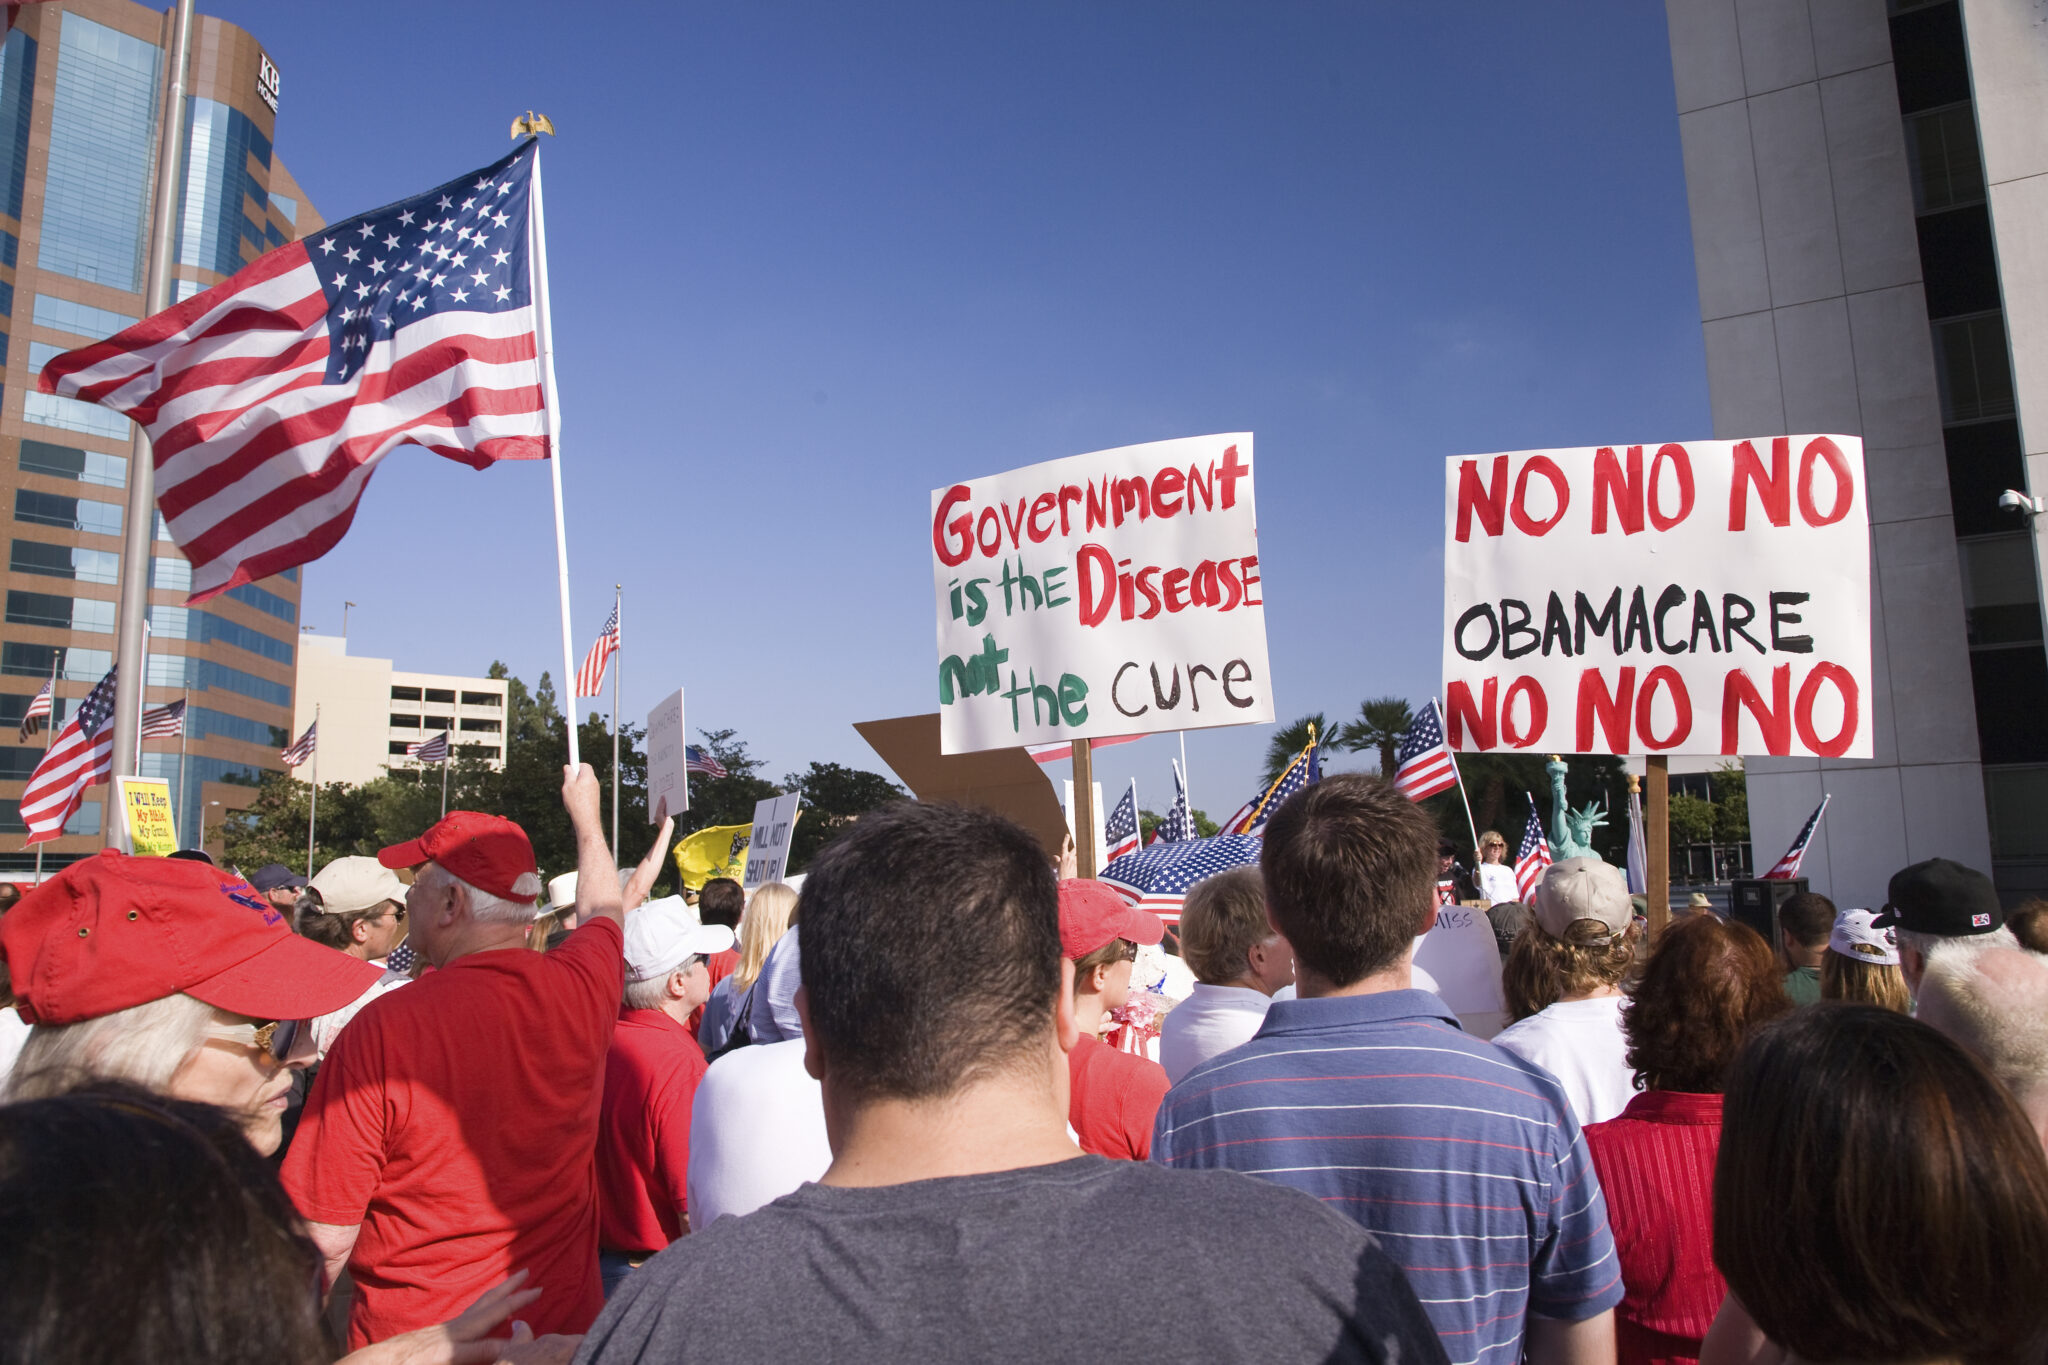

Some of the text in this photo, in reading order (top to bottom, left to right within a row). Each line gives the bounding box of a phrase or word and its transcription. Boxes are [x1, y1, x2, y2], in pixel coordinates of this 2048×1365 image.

[260, 53, 280, 96] KB
[257, 80, 279, 113] HOME
[1455, 436, 1854, 543] NO NO NO
[948, 577, 991, 627] is
[1454, 584, 1814, 661] OBAMACARE
[939, 632, 1009, 705] not
[1000, 665, 1089, 733] the
[1447, 661, 1859, 758] NO NO NO
[128, 791, 133, 806] I
[772, 798, 777, 821] I
[136, 809, 148, 824] My
[138, 825, 151, 839] My
[753, 822, 788, 848] WILL NOT
[746, 859, 765, 883] SHUT
